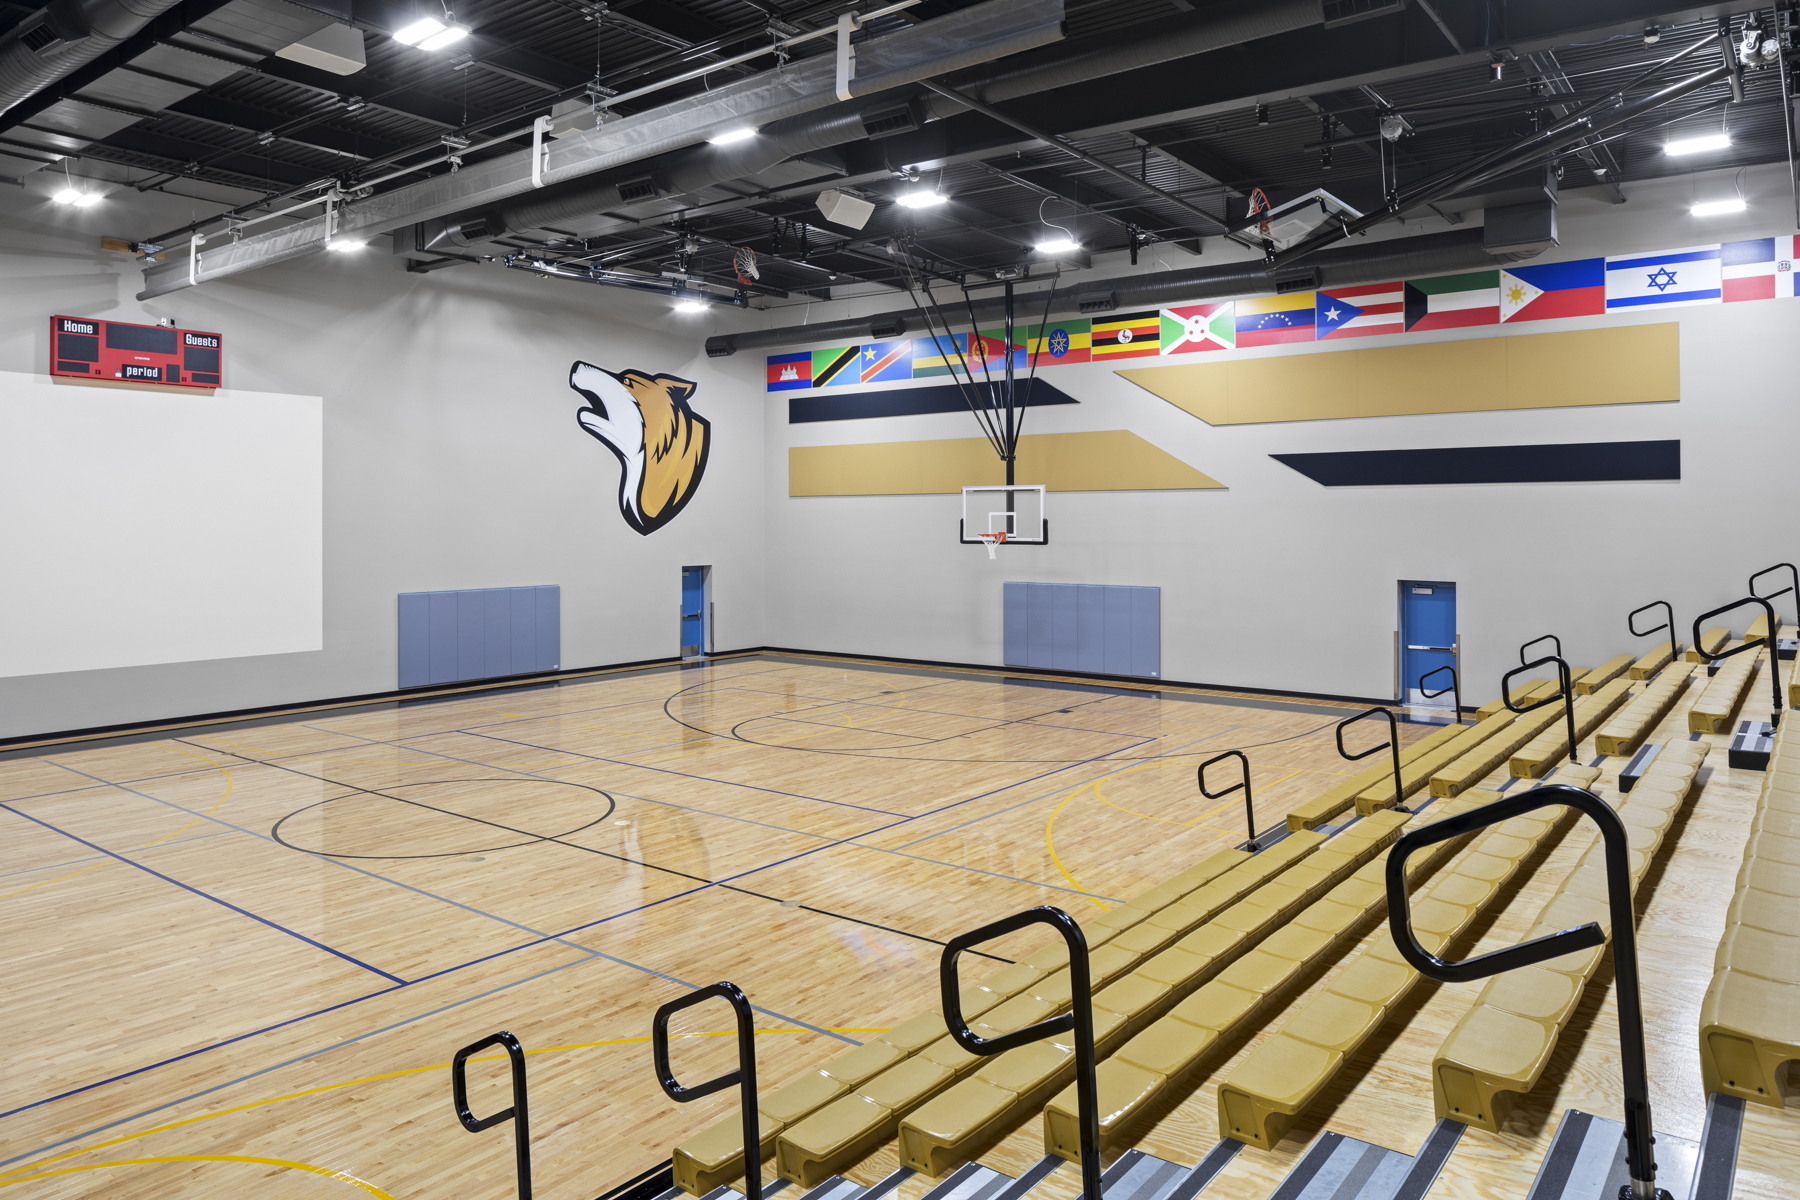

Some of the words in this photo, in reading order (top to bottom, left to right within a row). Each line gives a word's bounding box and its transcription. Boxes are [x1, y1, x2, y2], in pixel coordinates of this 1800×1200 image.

[64, 320, 93, 334] Home
[186, 334, 218, 348] Guests
[126, 366, 158, 378] period
